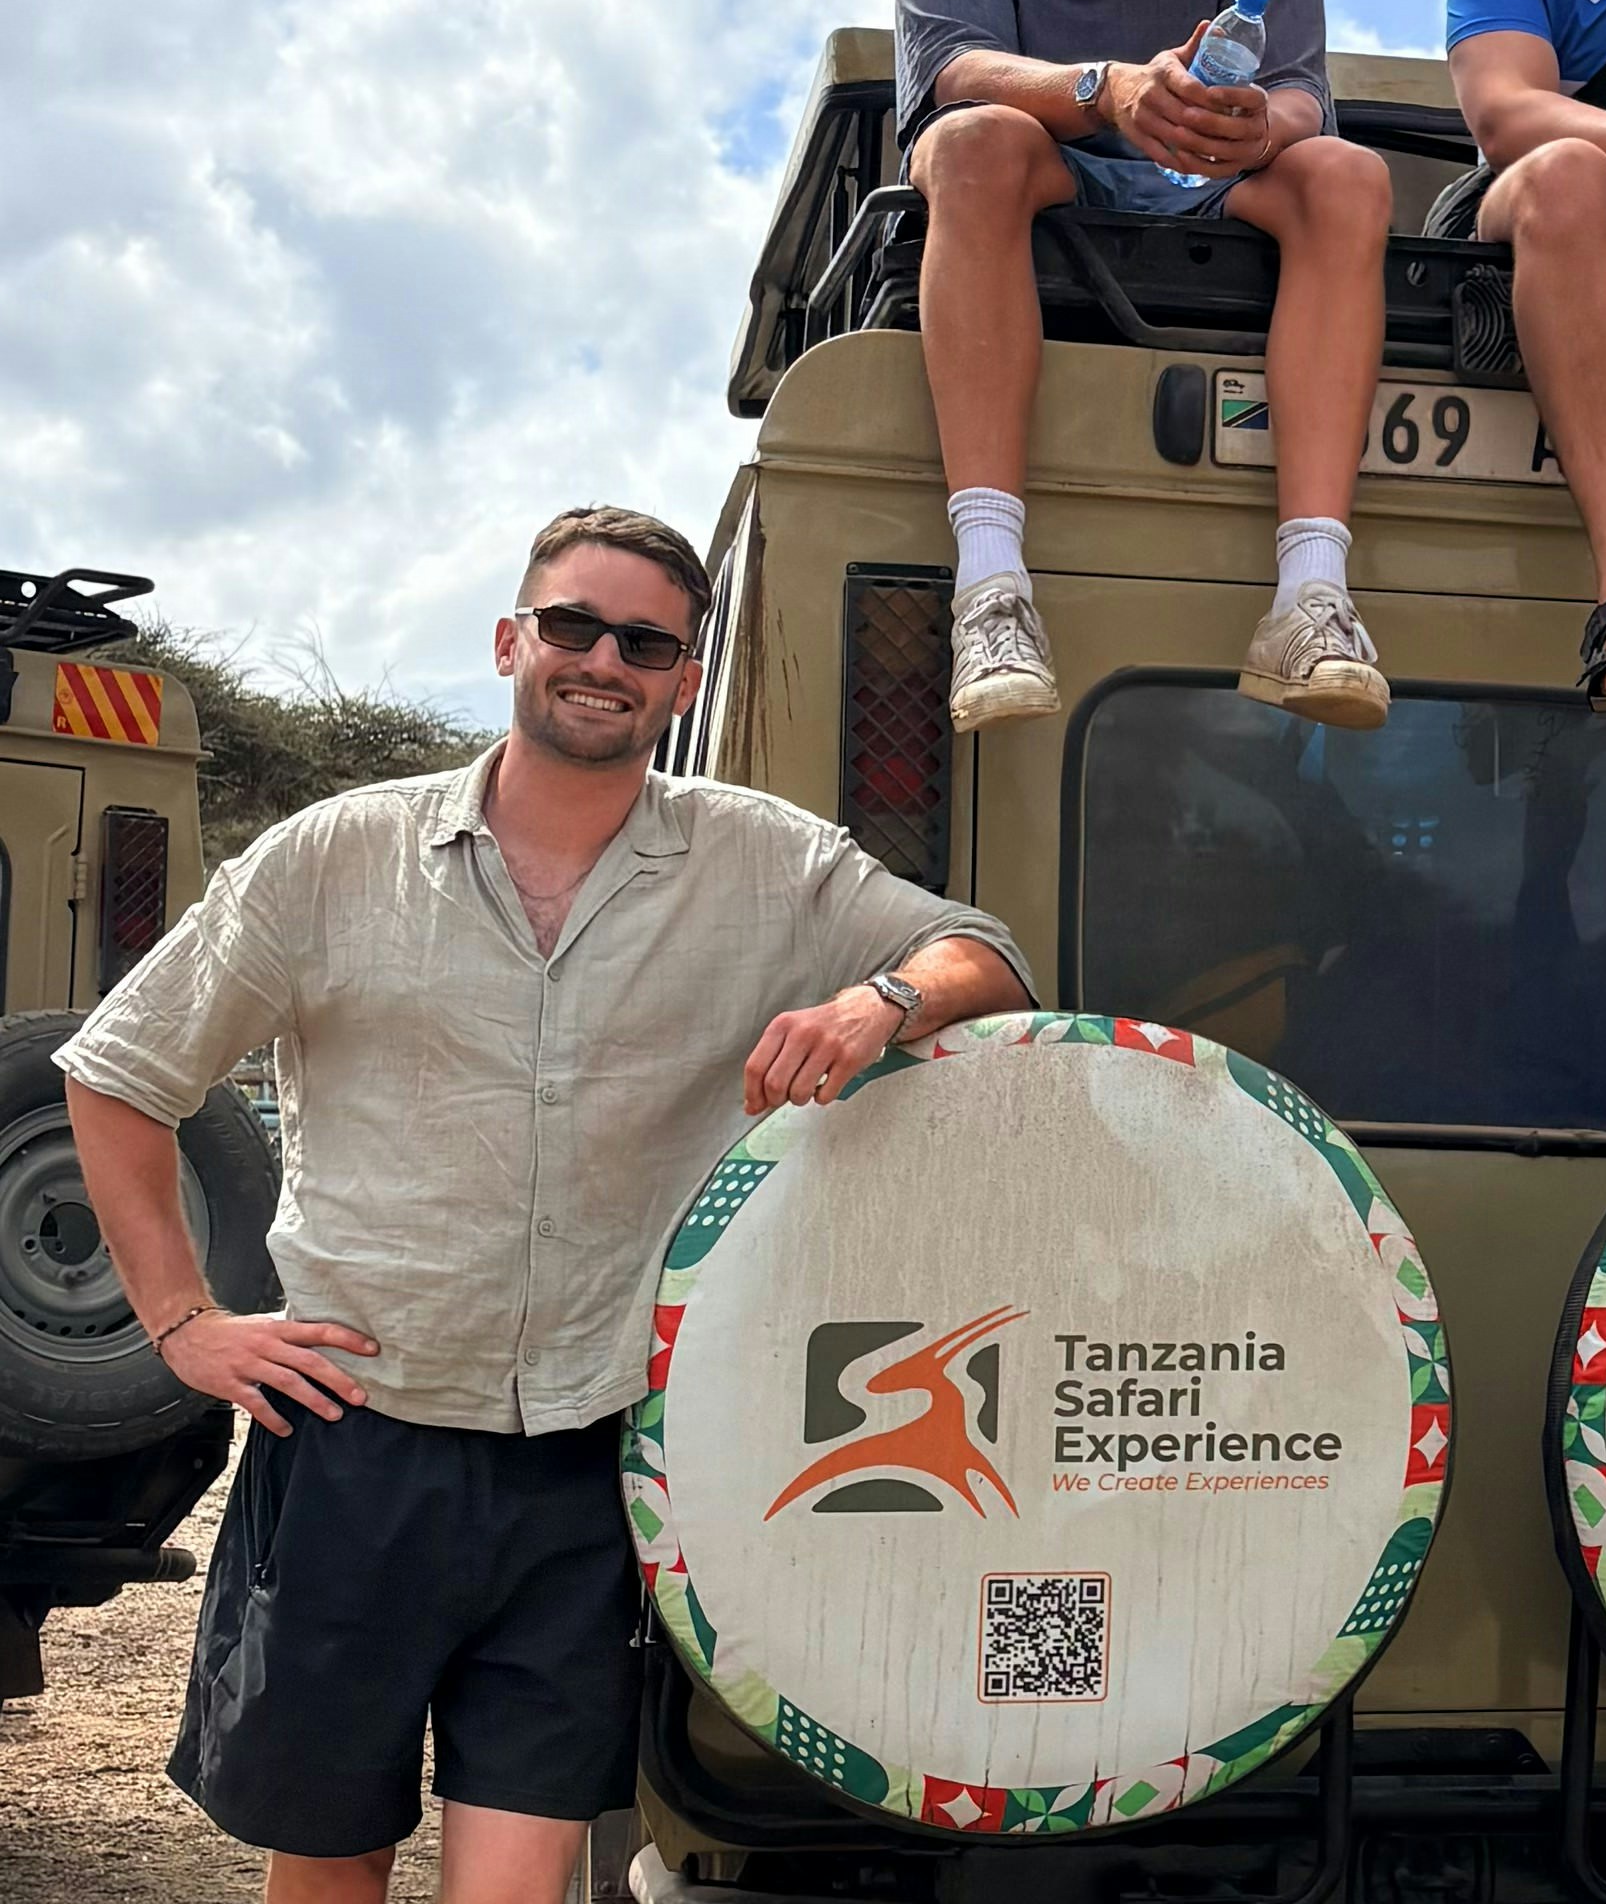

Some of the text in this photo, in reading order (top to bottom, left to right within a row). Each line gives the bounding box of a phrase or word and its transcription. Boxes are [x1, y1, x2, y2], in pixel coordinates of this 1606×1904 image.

[1361, 393, 1471, 467] 69
[56, 714, 67, 730] R
[1054, 1330, 1286, 1373] Tanzania
[1053, 1375, 1203, 1419] Safari
[1054, 1421, 1343, 1473] Experience
[1052, 1471, 1330, 1495] We Create Experiences
